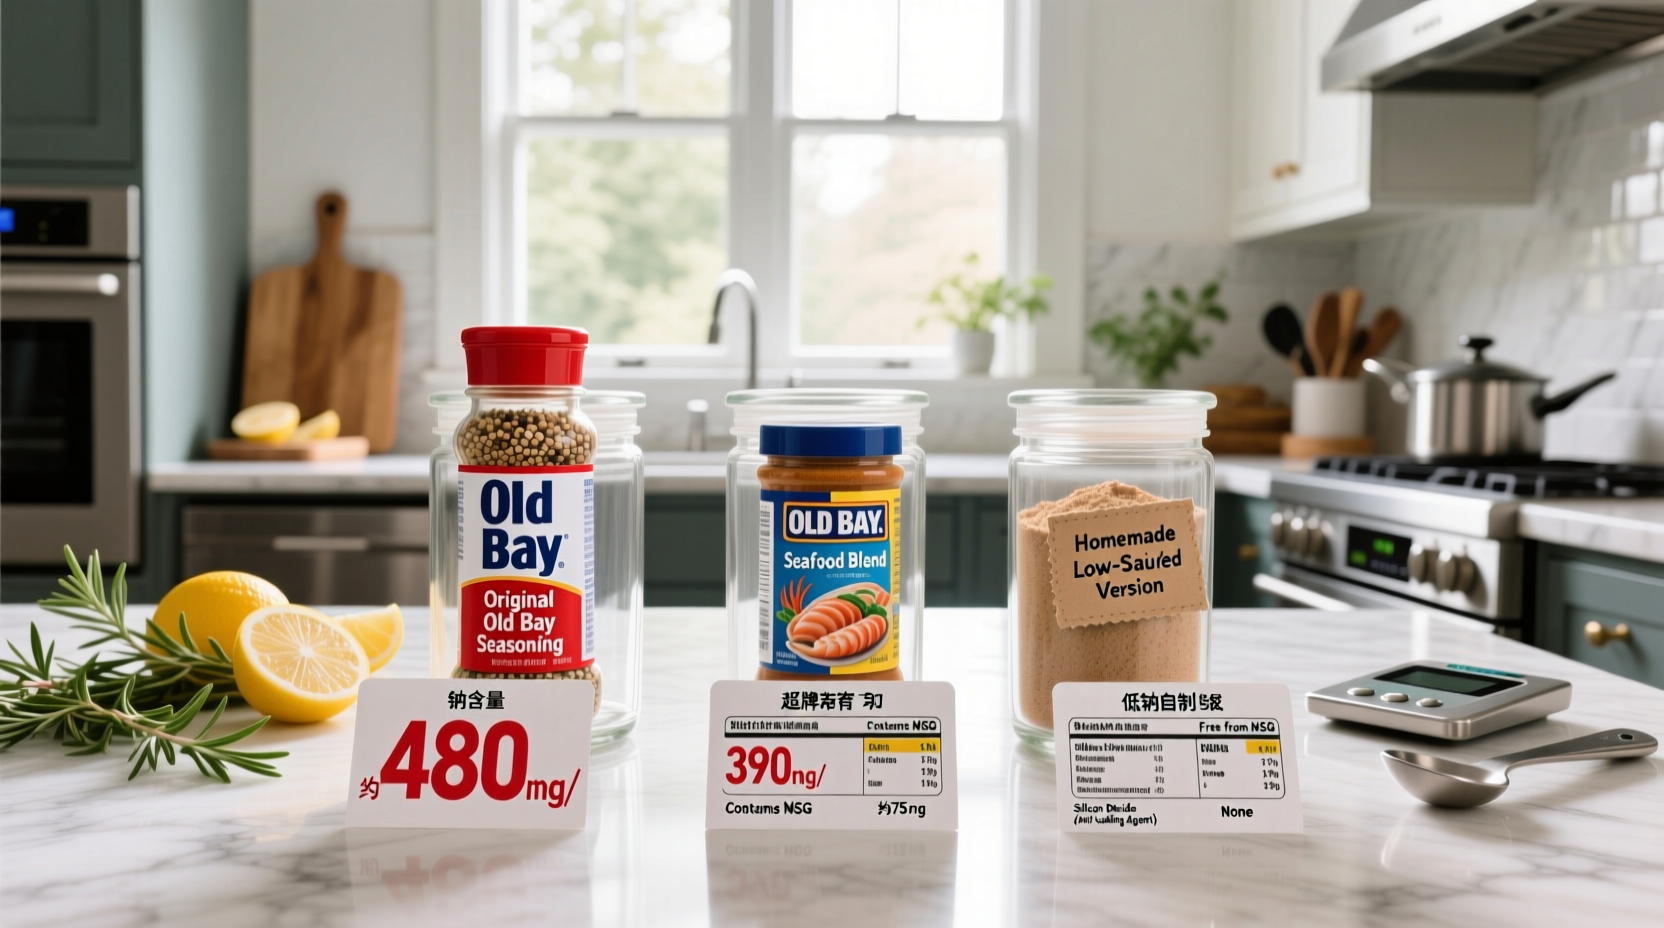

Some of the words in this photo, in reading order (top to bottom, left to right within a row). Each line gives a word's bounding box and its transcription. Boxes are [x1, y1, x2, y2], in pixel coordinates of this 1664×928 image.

[480, 479, 553, 525] Old
[788, 509, 832, 535] OLD
[1075, 524, 1176, 552] Homemade
[482, 528, 563, 577] Bay
[783, 551, 844, 569] Seafood
[848, 550, 887, 568] Blend
[1095, 578, 1164, 599] Version
[483, 589, 554, 612] Original
[483, 612, 514, 632] Old
[520, 612, 556, 635] Bay
[476, 634, 564, 657] Seasoning
[447, 690, 505, 710] 钠含量
[1199, 721, 1221, 732] Free
[1224, 720, 1249, 732] from
[783, 800, 812, 815] NSG
[1220, 805, 1254, 818] None
